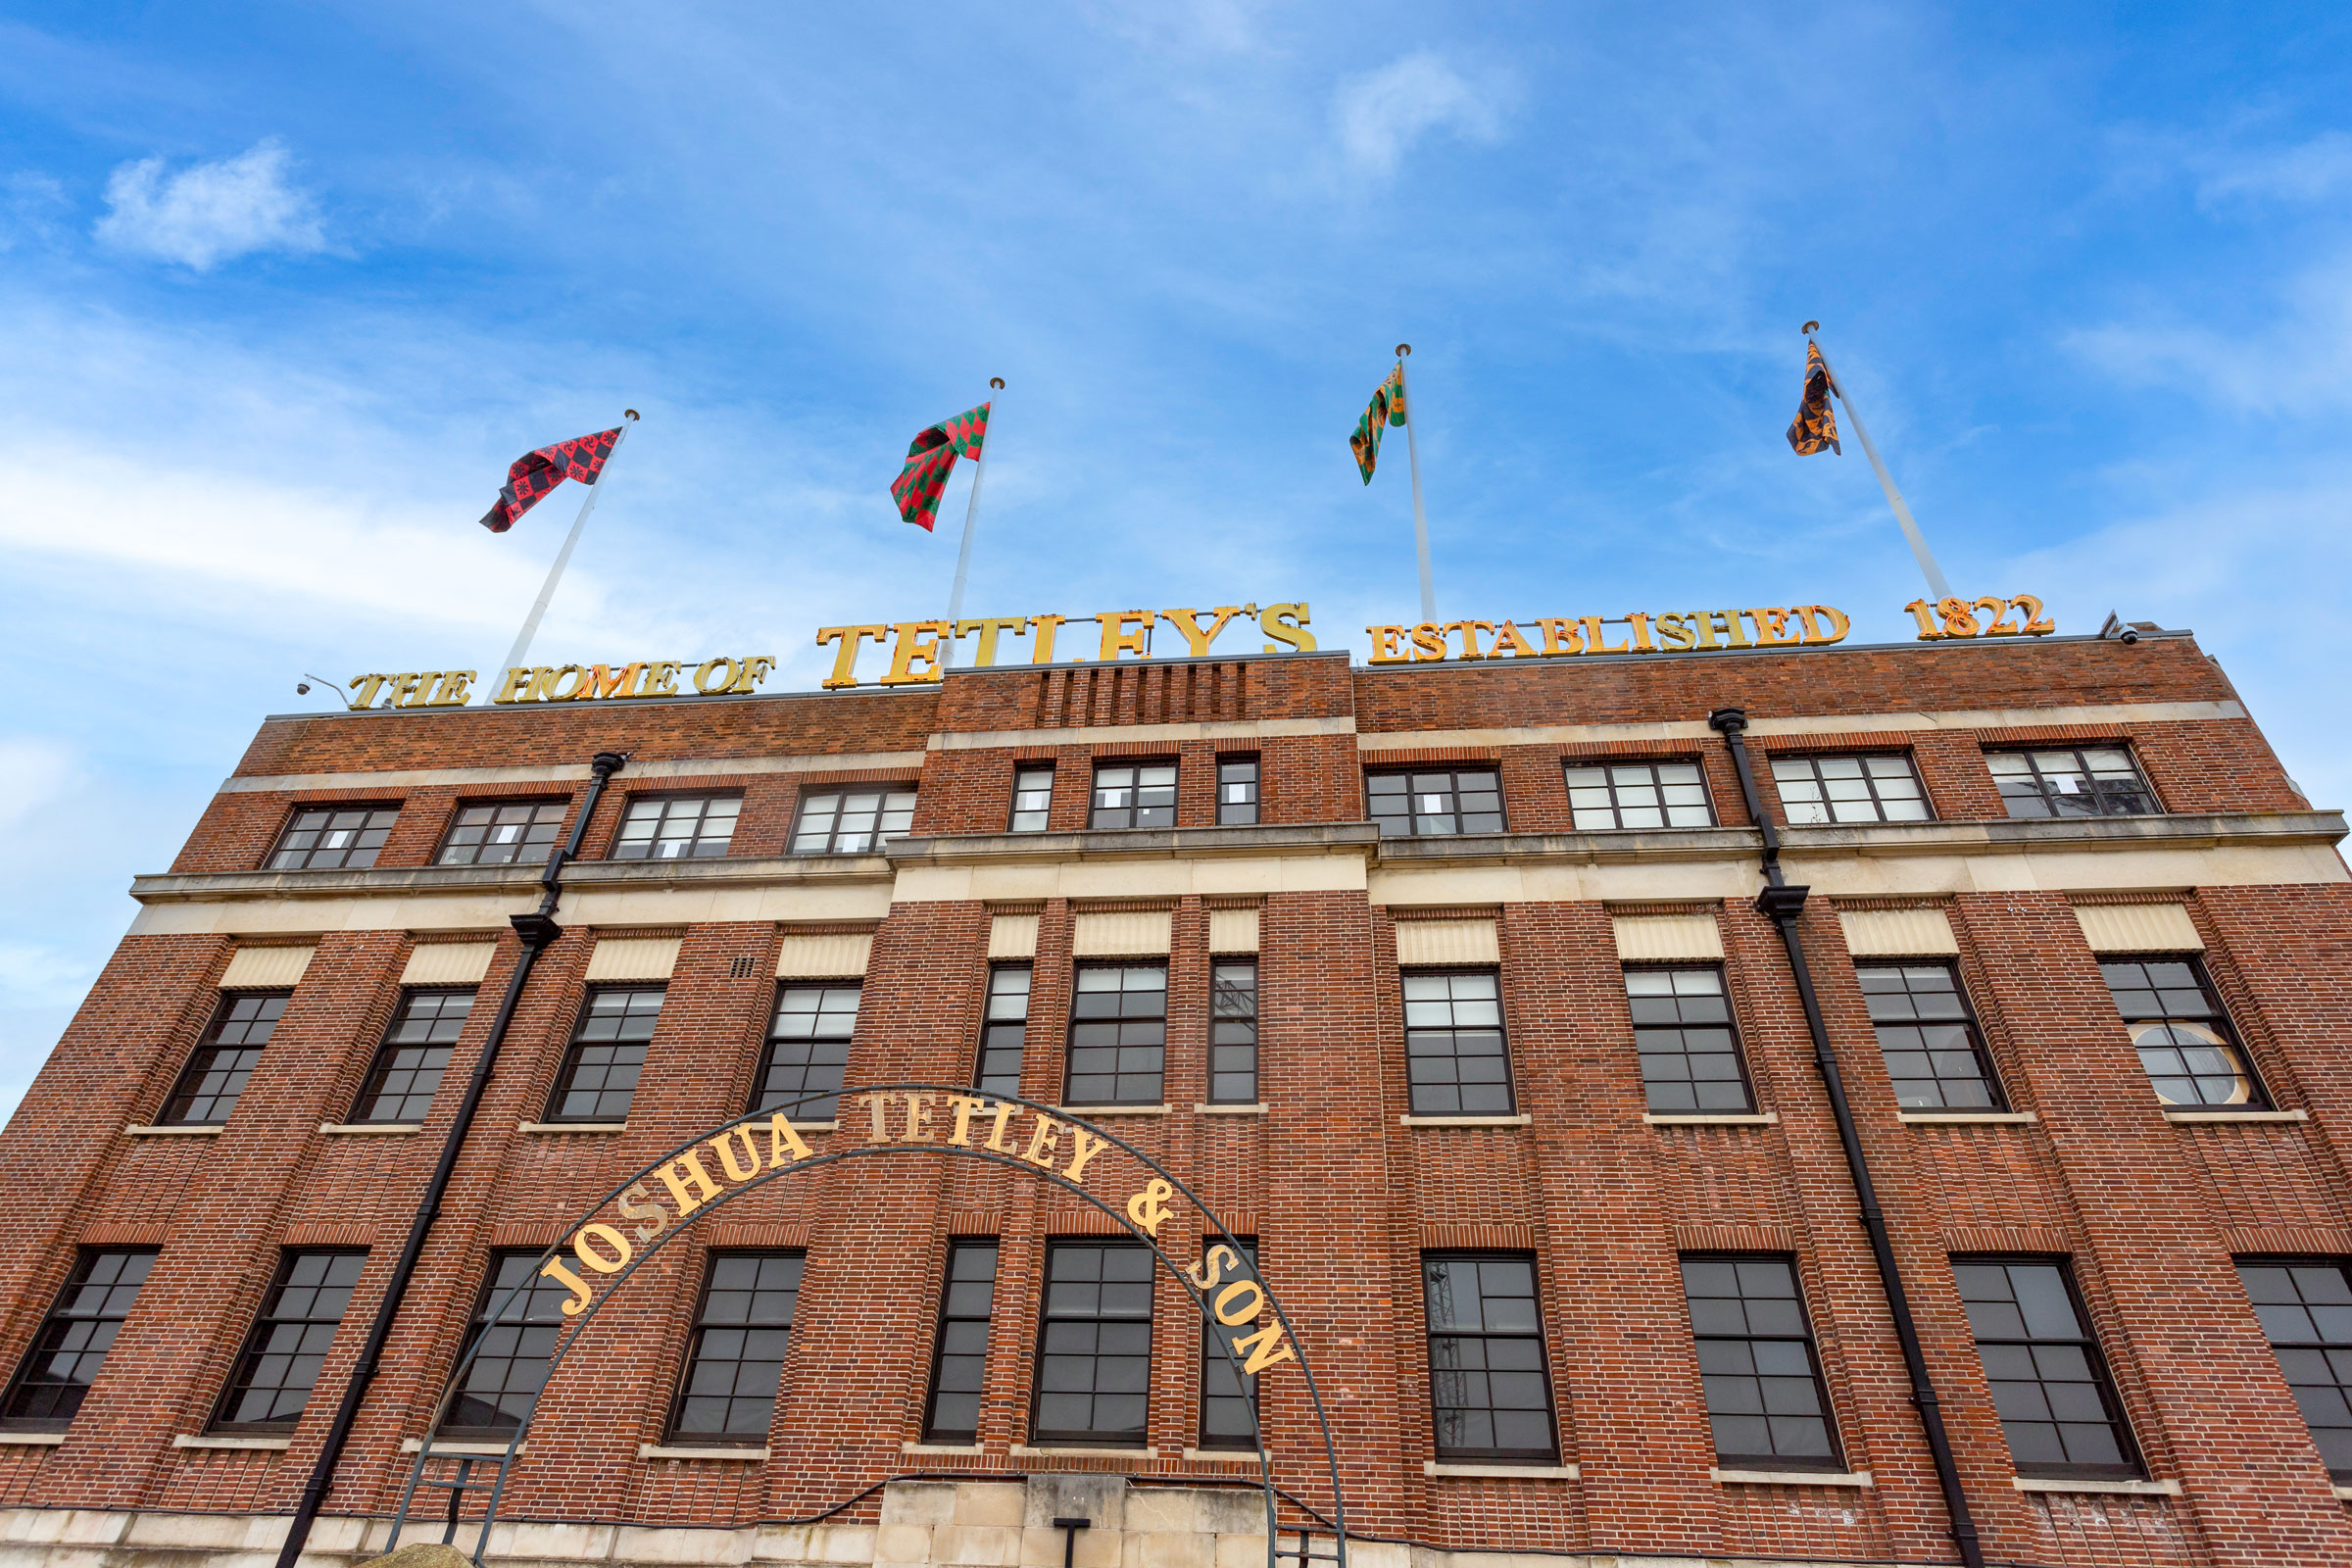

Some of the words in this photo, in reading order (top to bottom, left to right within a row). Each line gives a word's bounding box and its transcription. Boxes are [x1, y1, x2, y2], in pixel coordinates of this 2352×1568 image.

[816, 602, 1318, 690] TETLEY'S
[1366, 605, 1850, 664] ESTABLISHED
[1904, 595, 2055, 641] 1822
[349, 669, 477, 710] THE
[493, 661, 680, 705] HOME
[694, 656, 776, 696] OF
[540, 1113, 813, 1316] JOSHUA
[858, 1091, 1109, 1183] TETLEY
[1127, 1178, 1173, 1237] &
[1187, 1244, 1296, 1376] SON
